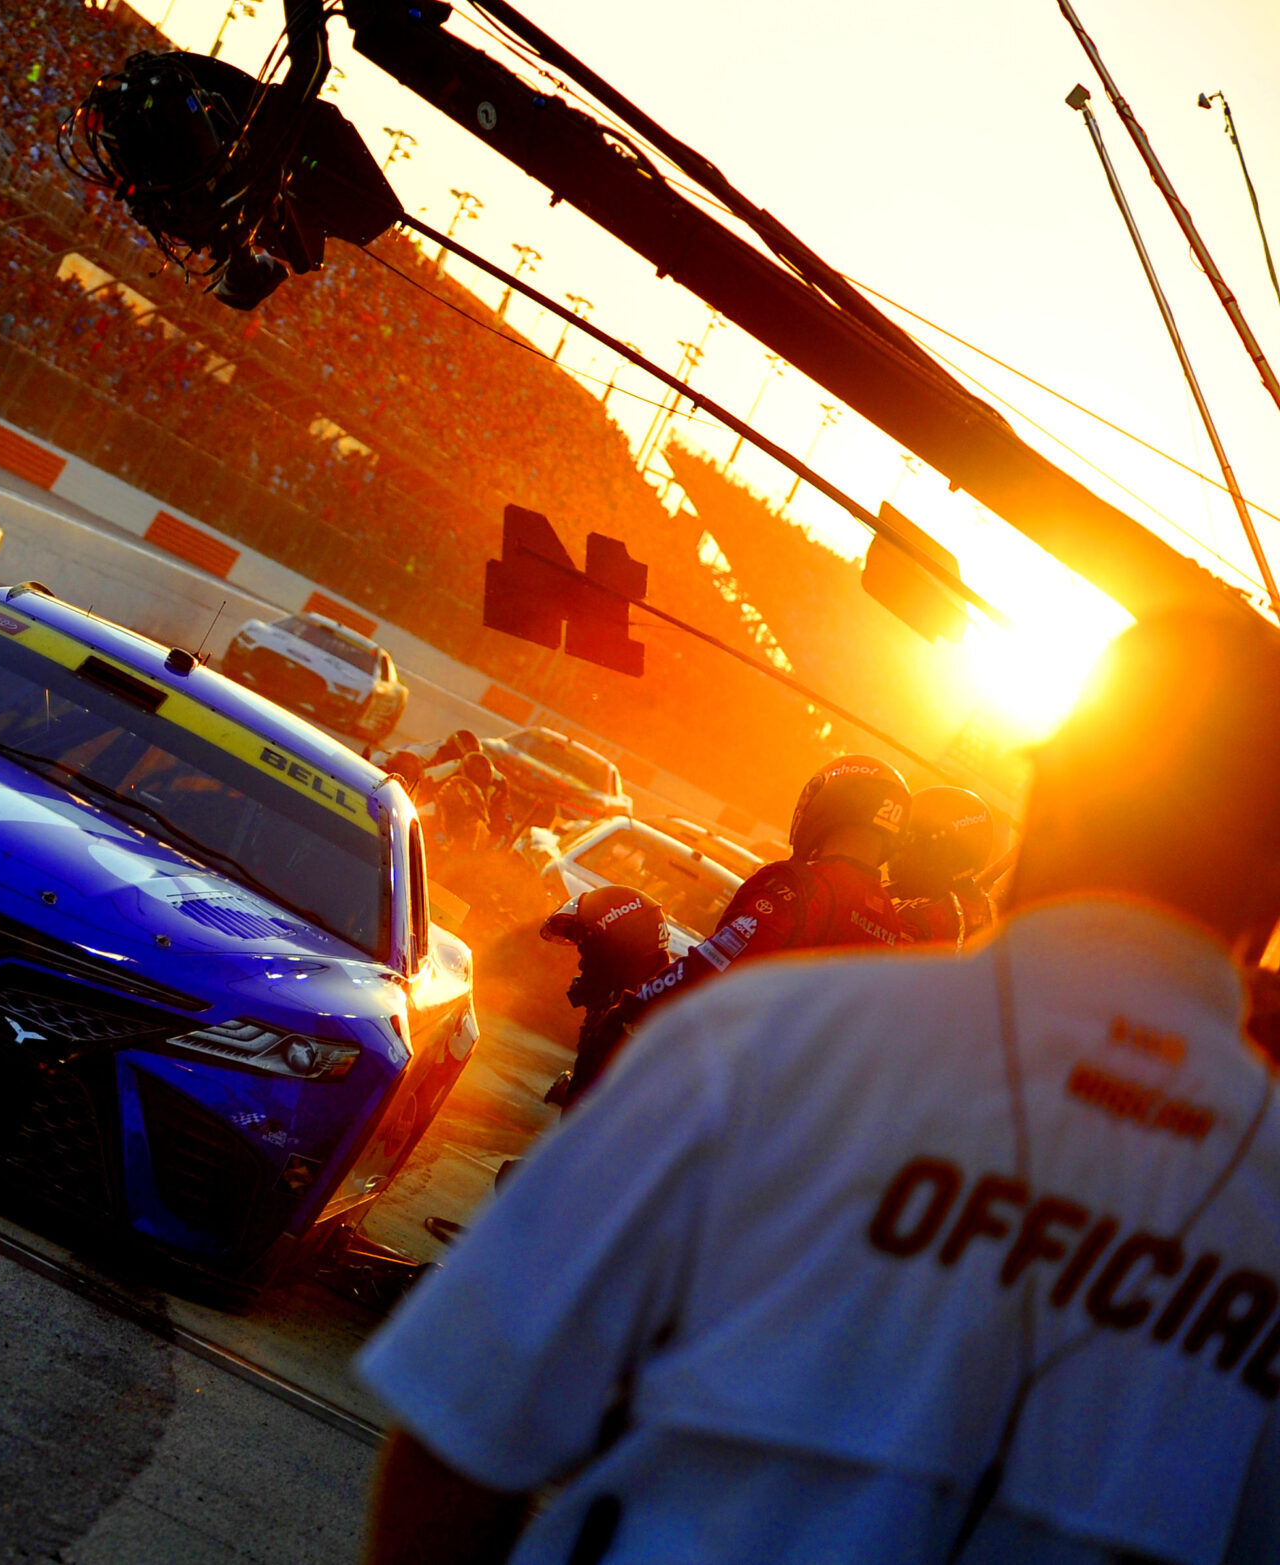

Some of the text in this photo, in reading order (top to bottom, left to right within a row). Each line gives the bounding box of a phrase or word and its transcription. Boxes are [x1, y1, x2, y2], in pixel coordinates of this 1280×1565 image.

[260, 747, 357, 814] BELL
[876, 799, 903, 823] 20
[597, 898, 643, 930] yahoo!
[636, 962, 684, 1000] hoo!
